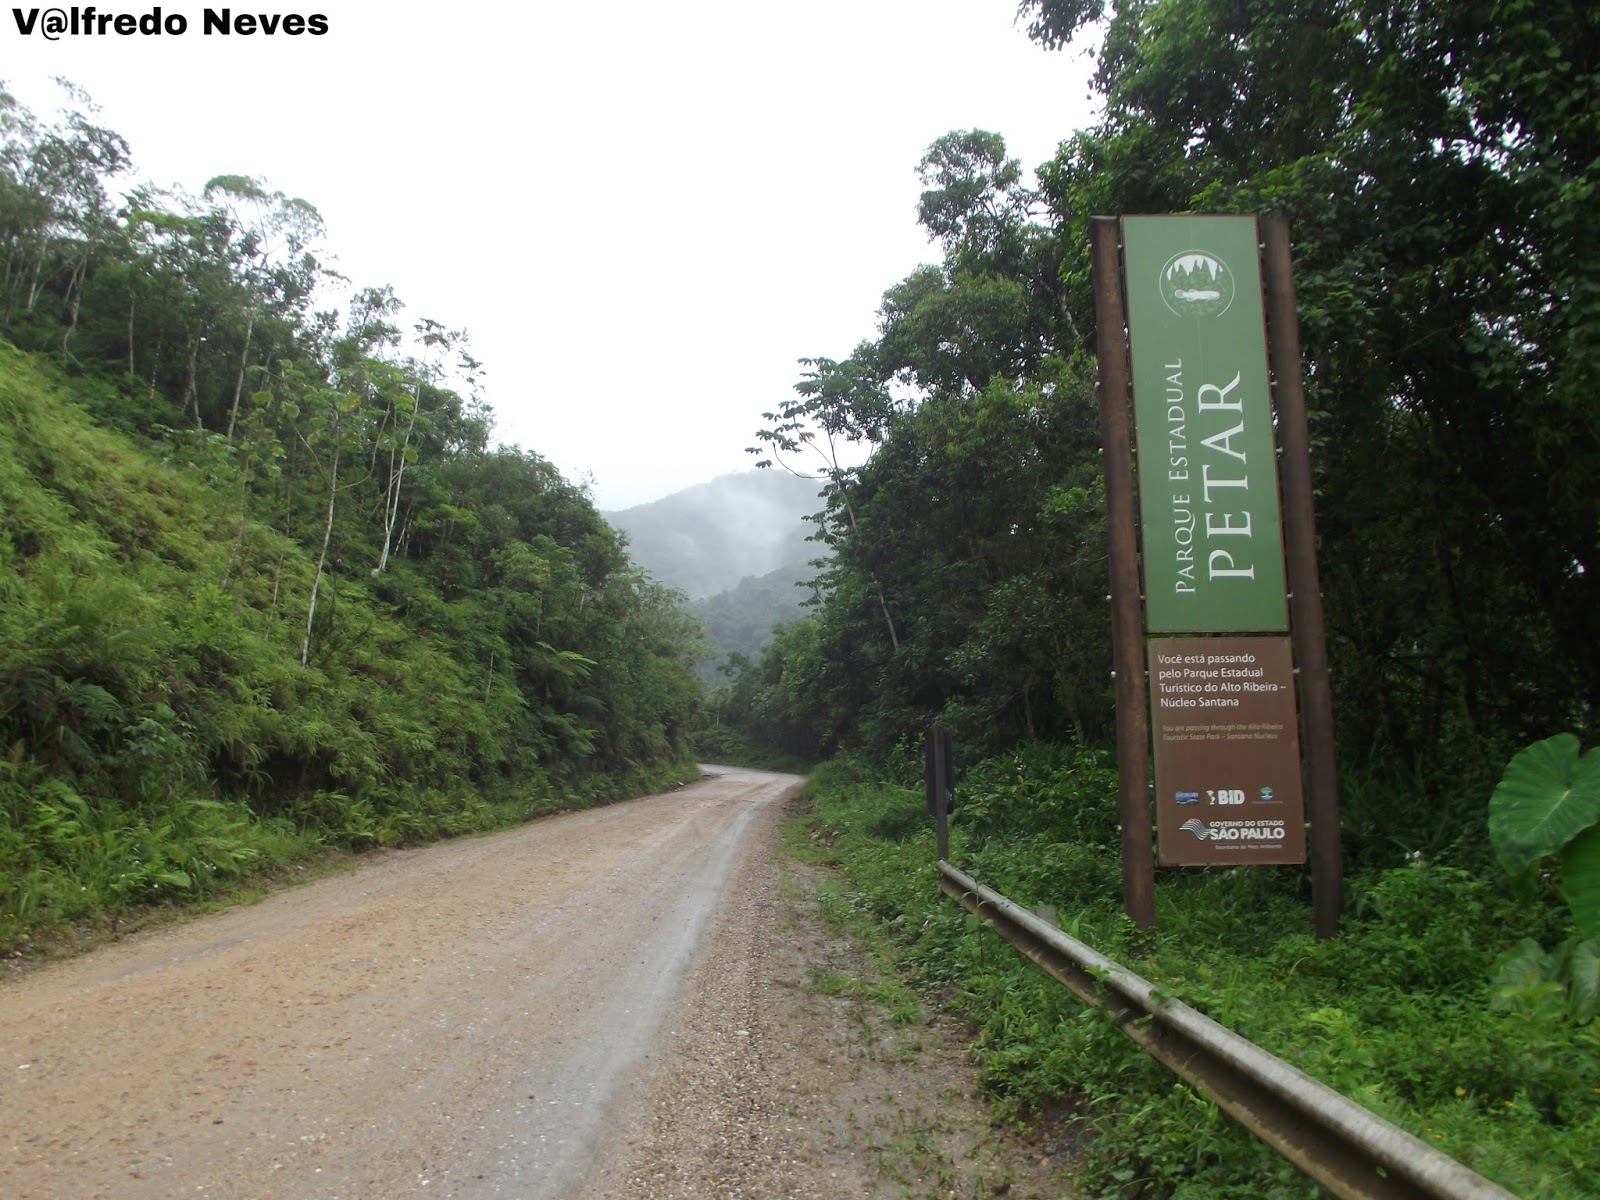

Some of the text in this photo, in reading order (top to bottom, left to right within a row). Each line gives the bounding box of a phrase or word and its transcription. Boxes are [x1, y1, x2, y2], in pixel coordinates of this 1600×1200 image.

[1165, 358, 1196, 594] PARQUE ESTADUAL
[1197, 370, 1255, 581] PETAR
[1158, 653, 1256, 665] Você está passando
[1159, 667, 1264, 680] pelo Parque Estadual
[1159, 683, 1203, 693] Turístico
[1204, 682, 1218, 692] do
[1220, 682, 1241, 692] Alto
[1243, 682, 1278, 692] Ribeira
[1160, 697, 1240, 707] Núcleo Santana
[1217, 789, 1246, 805] BID
[1209, 820, 1244, 828] GOVERNO
[1256, 819, 1285, 827] ESTADO
[1209, 827, 1285, 840] SÃO PAULO
